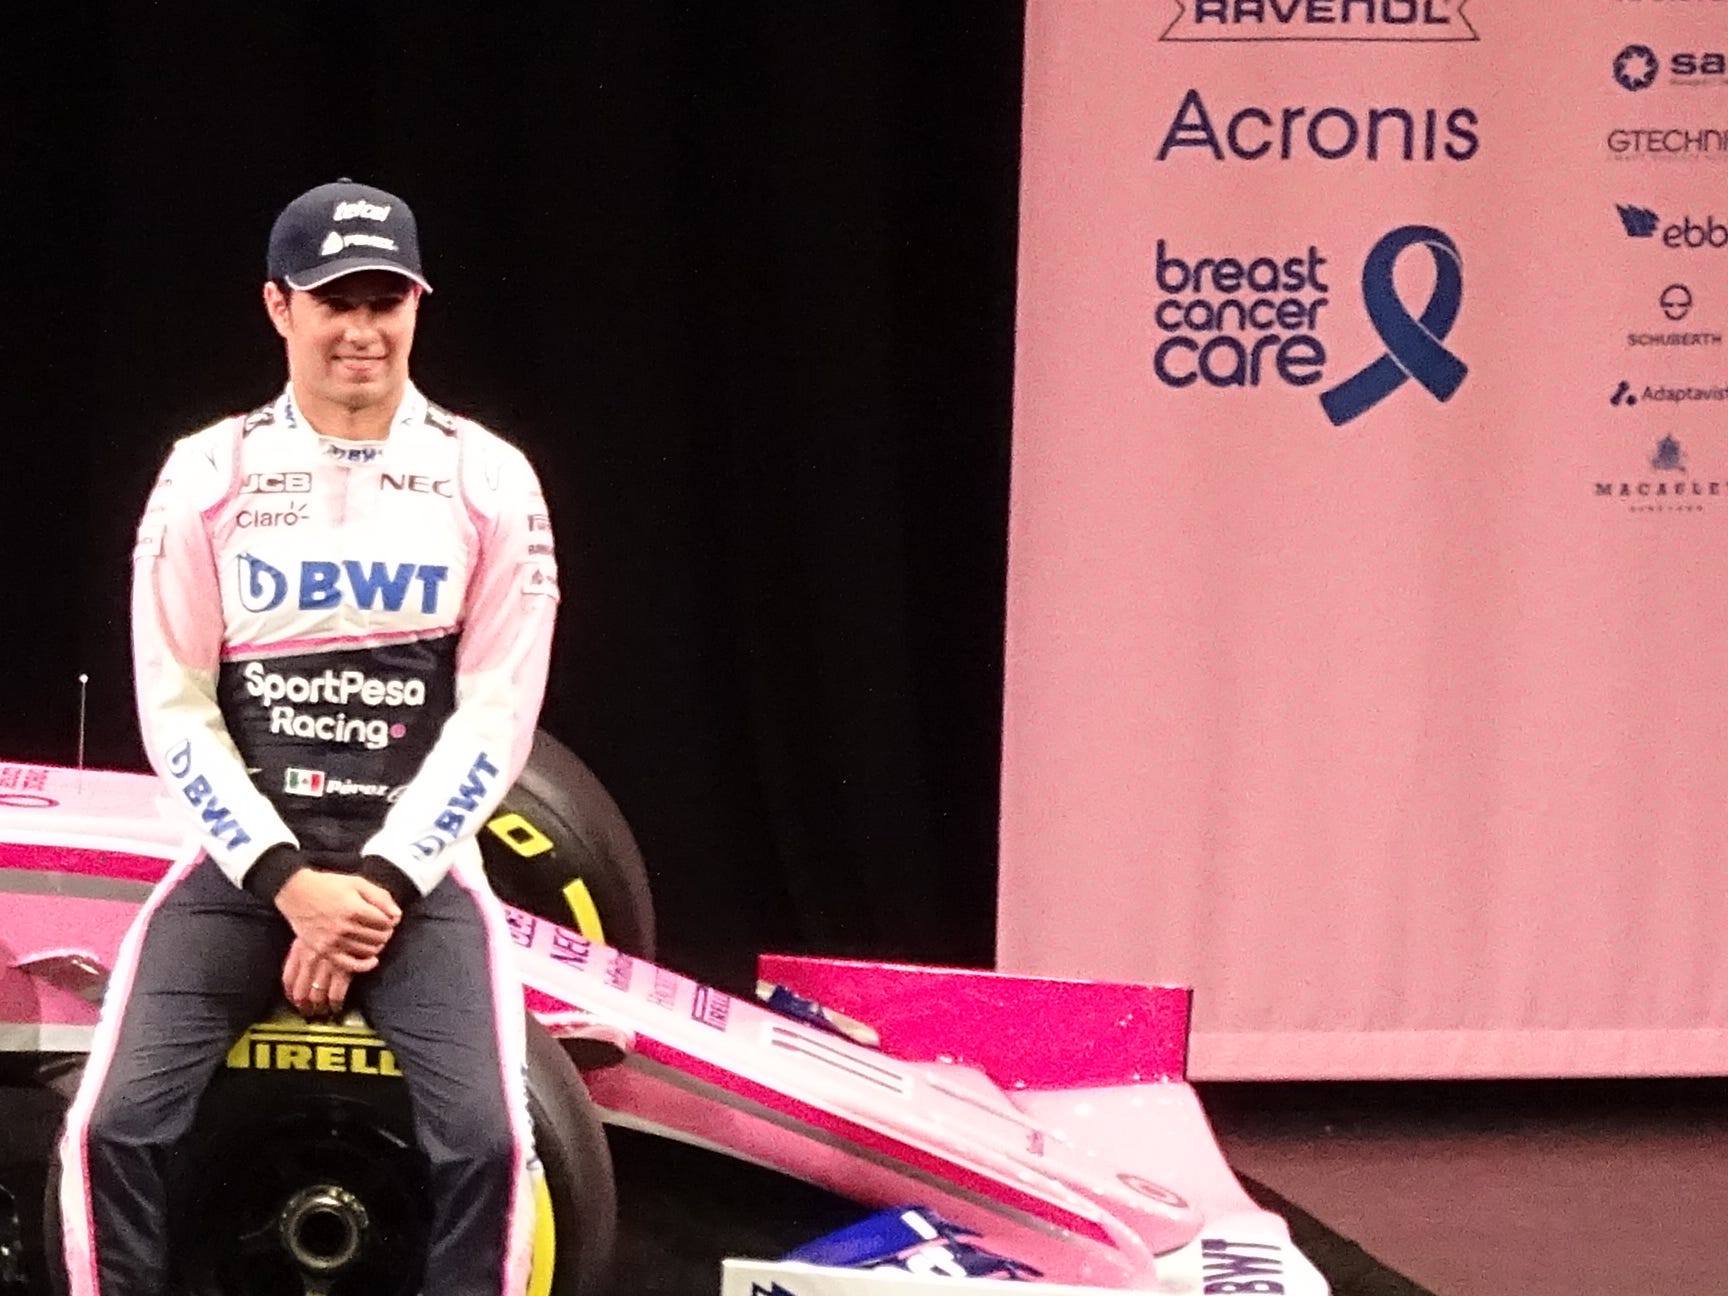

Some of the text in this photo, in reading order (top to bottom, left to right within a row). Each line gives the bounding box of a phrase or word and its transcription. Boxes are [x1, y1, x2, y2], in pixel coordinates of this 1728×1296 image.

[1155, 88, 1481, 161] Acronis
[1155, 238, 1330, 294] breast
[1154, 297, 1329, 332] cancer
[1152, 333, 1328, 388] care
[242, 471, 313, 494] JCB
[379, 473, 454, 499] NEC
[235, 509, 300, 529] Claro
[297, 559, 449, 615] BWT
[243, 661, 426, 708] SportPesa
[271, 707, 389, 749] Racing
[183, 773, 251, 852] BWT
[435, 751, 501, 841] BWT
[549, 925, 591, 972] NEC
[226, 1023, 404, 1078] PIRELL
[1200, 1238, 1285, 1296] BWT
